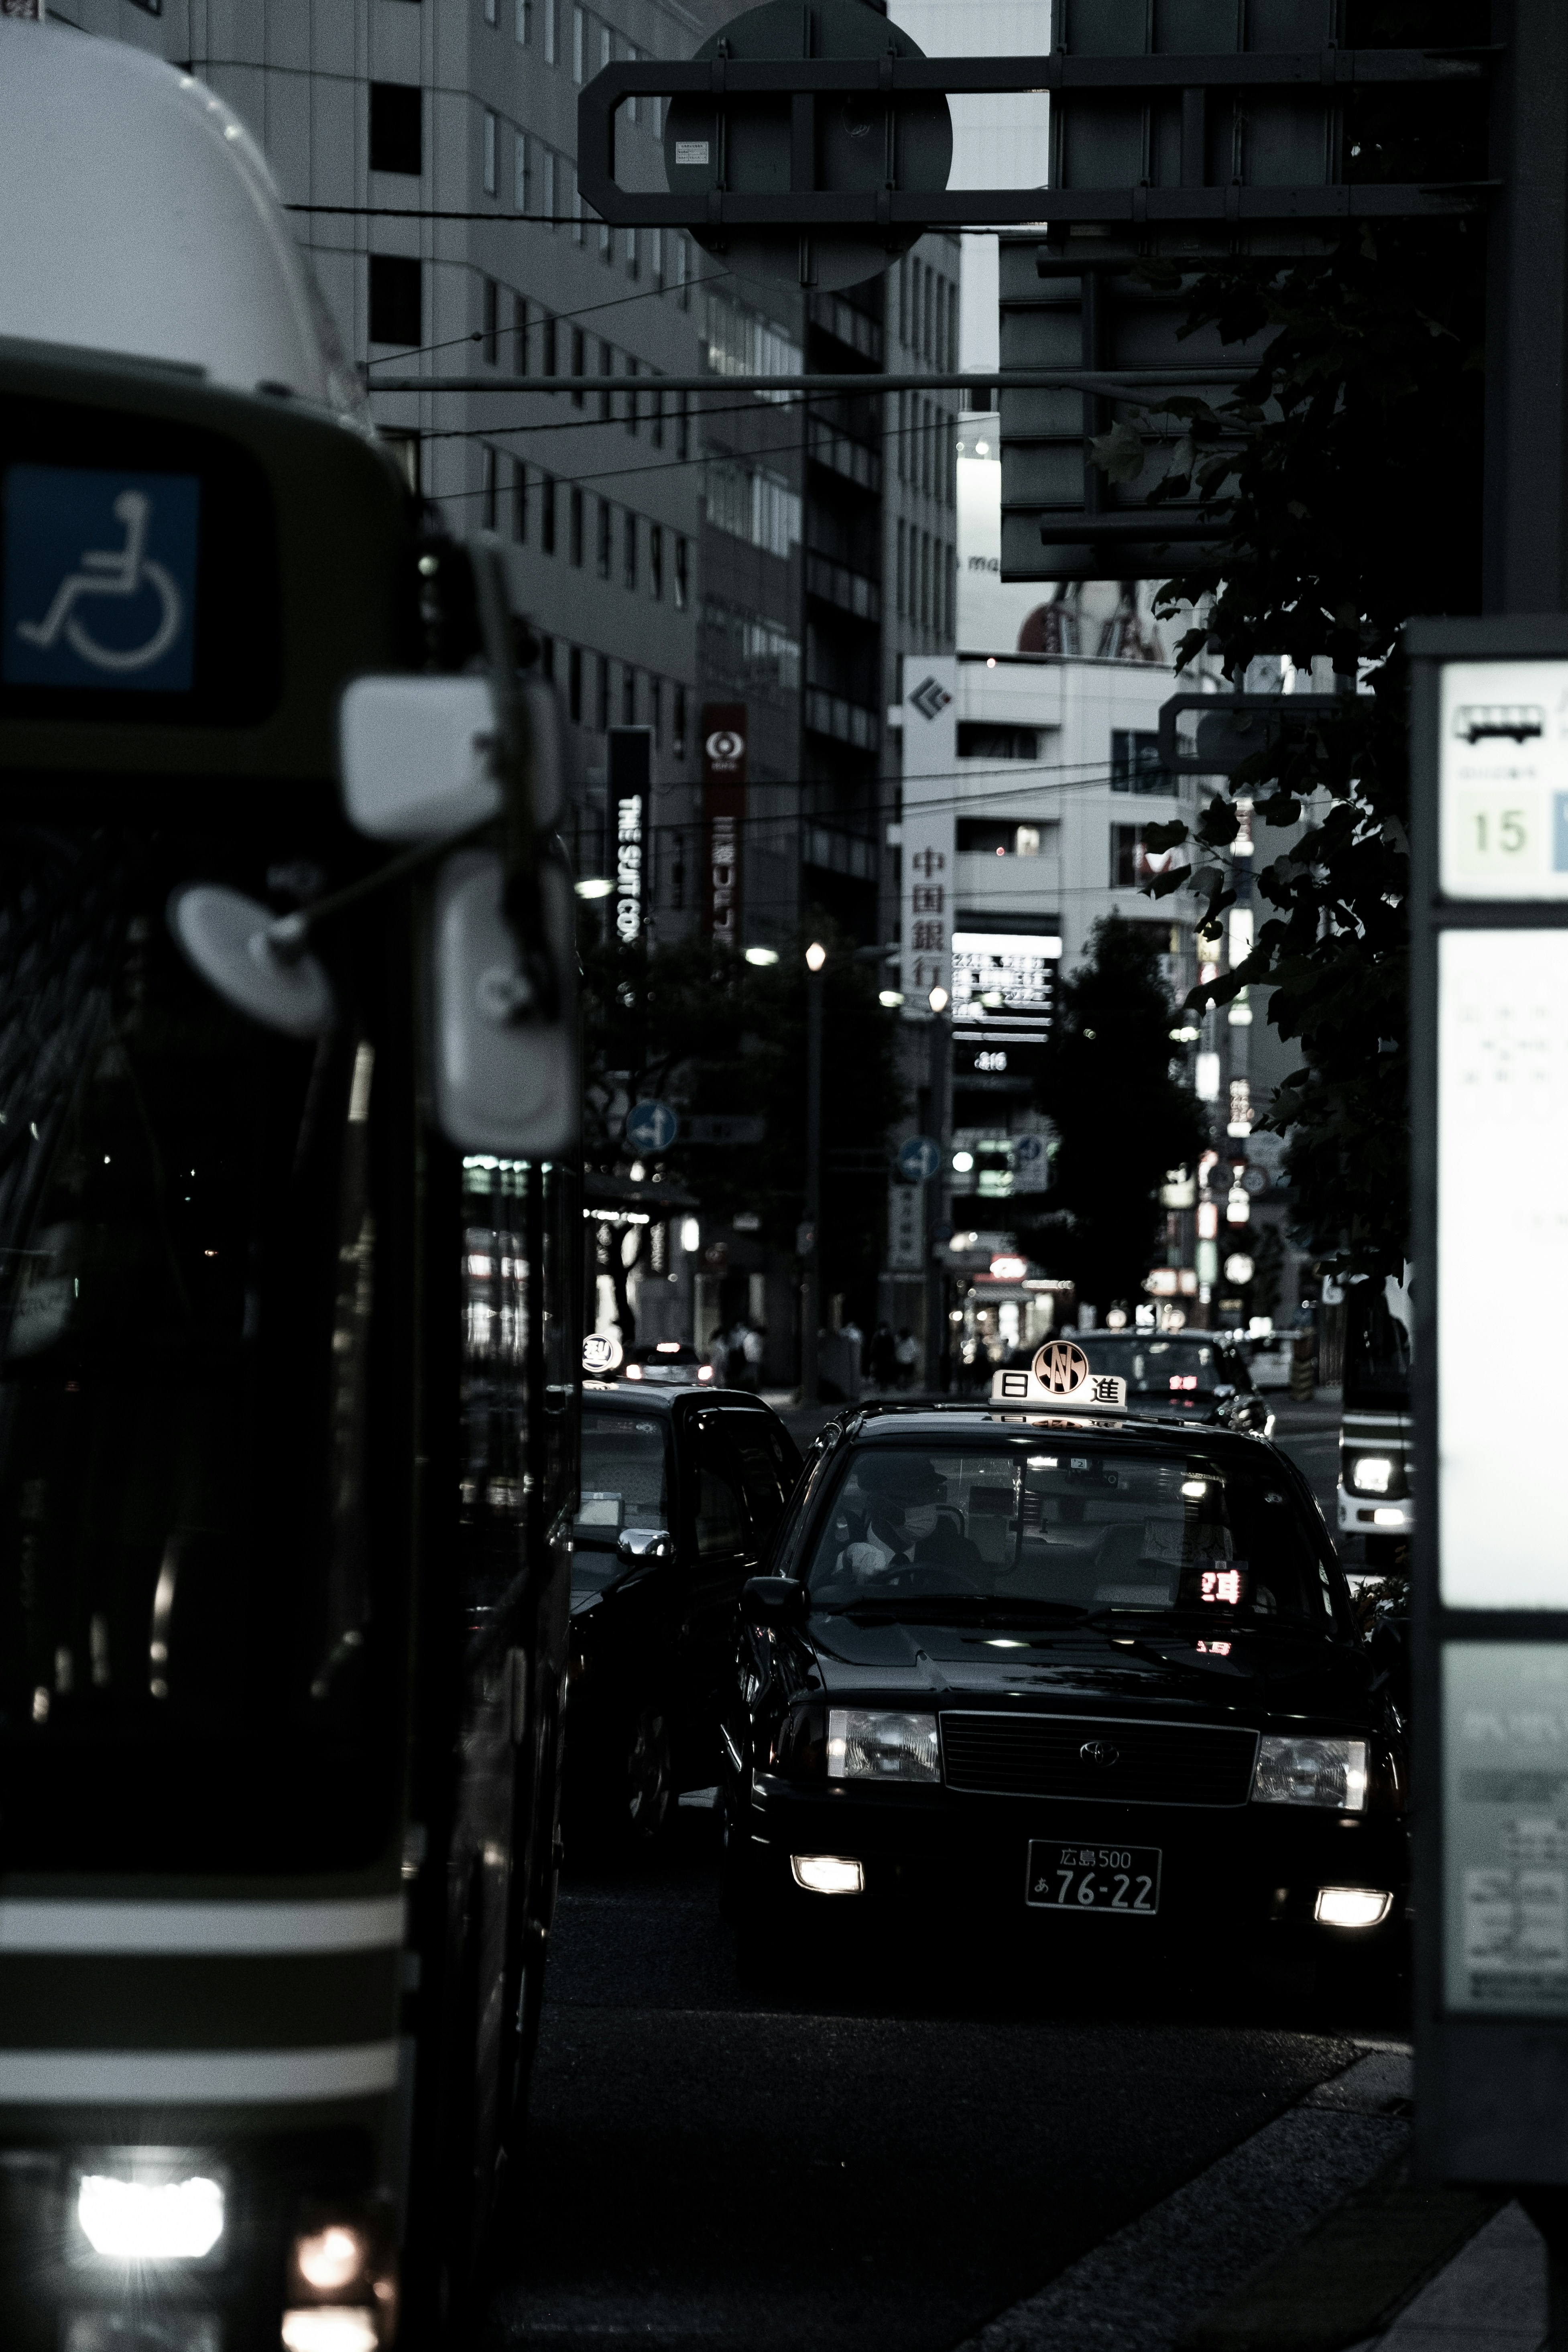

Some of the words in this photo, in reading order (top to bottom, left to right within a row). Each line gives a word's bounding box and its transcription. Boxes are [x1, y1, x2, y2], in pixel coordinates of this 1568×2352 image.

[1473, 810, 1527, 853] 15
[617, 844, 641, 898] SUIT
[1034, 1876, 1049, 1894] あ
[1056, 1869, 1152, 1909] 76-22
